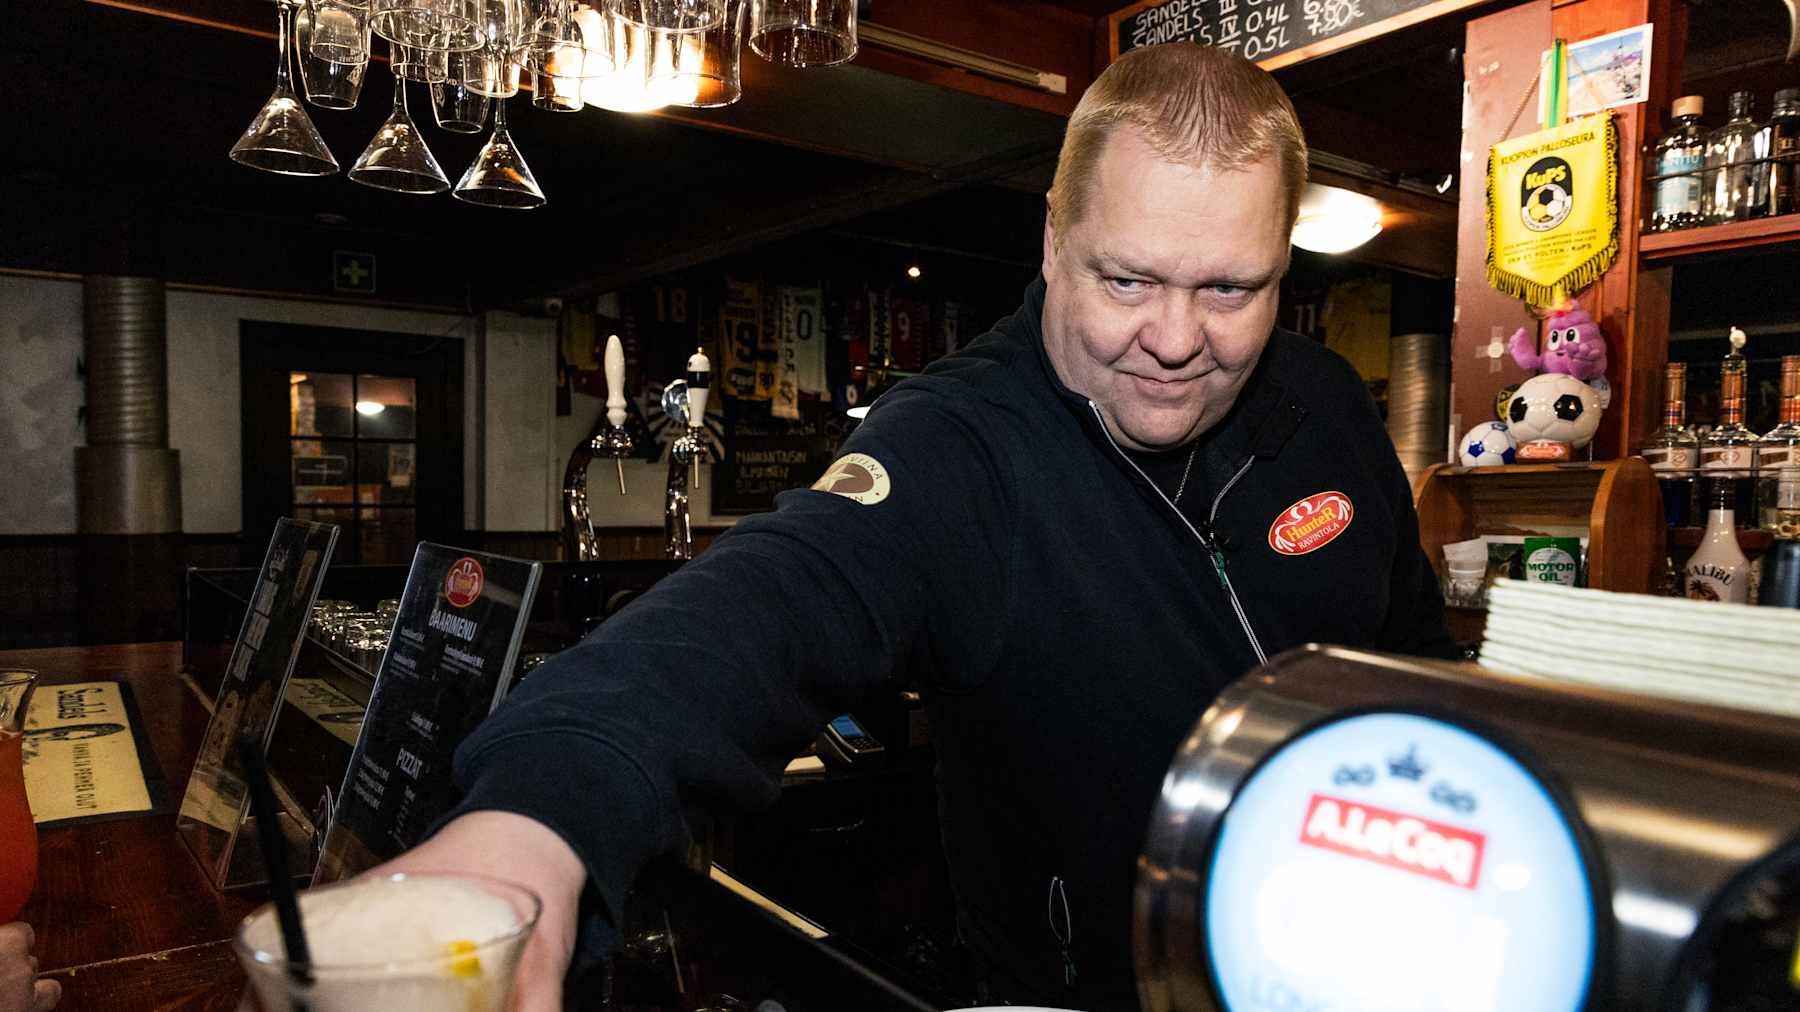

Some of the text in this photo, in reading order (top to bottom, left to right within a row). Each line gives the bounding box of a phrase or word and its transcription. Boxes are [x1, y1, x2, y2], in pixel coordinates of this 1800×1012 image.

[1245, 3, 1290, 33] 0.4L
[1501, 131, 1595, 165] KUOPION PALLOSEURA
[1525, 164, 1567, 190] KuPS
[1298, 521, 1340, 550] RAVINTOLA
[1528, 562, 1574, 572] MOTOR
[1538, 572, 1562, 583] OIL
[428, 608, 479, 642] BAARIMENU
[396, 747, 422, 780] PIZZAT
